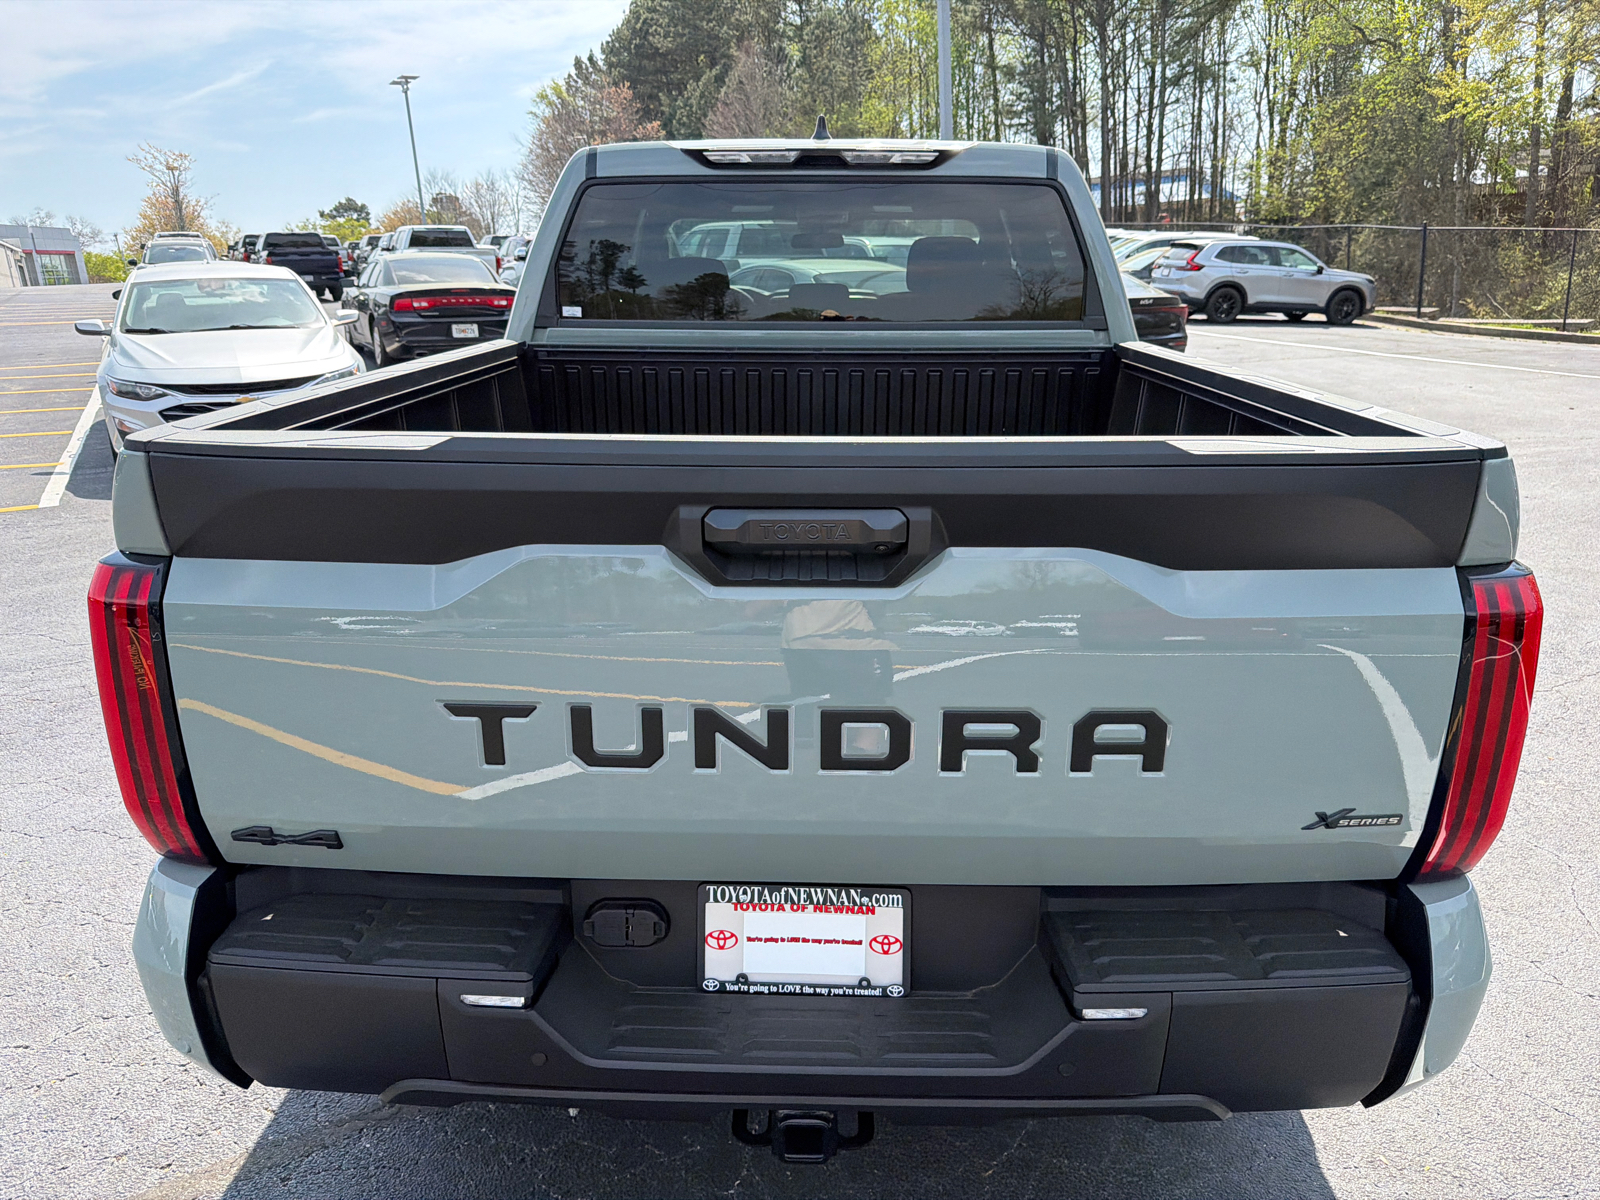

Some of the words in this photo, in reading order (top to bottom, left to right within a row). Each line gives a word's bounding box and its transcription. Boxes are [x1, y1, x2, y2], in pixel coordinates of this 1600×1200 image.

[759, 523, 852, 541] TOYOTA
[440, 701, 1170, 775] TUNDRA
[731, 902, 786, 912] TOYOTA
[790, 903, 809, 912] OF
[813, 904, 876, 916] NEWNAN
[725, 983, 748, 991] You're
[749, 984, 769, 993] going
[778, 985, 801, 993] LOVE
[802, 985, 814, 994] the
[815, 987, 830, 996] way
[830, 986, 854, 996] you're
[854, 988, 883, 996] treated!
